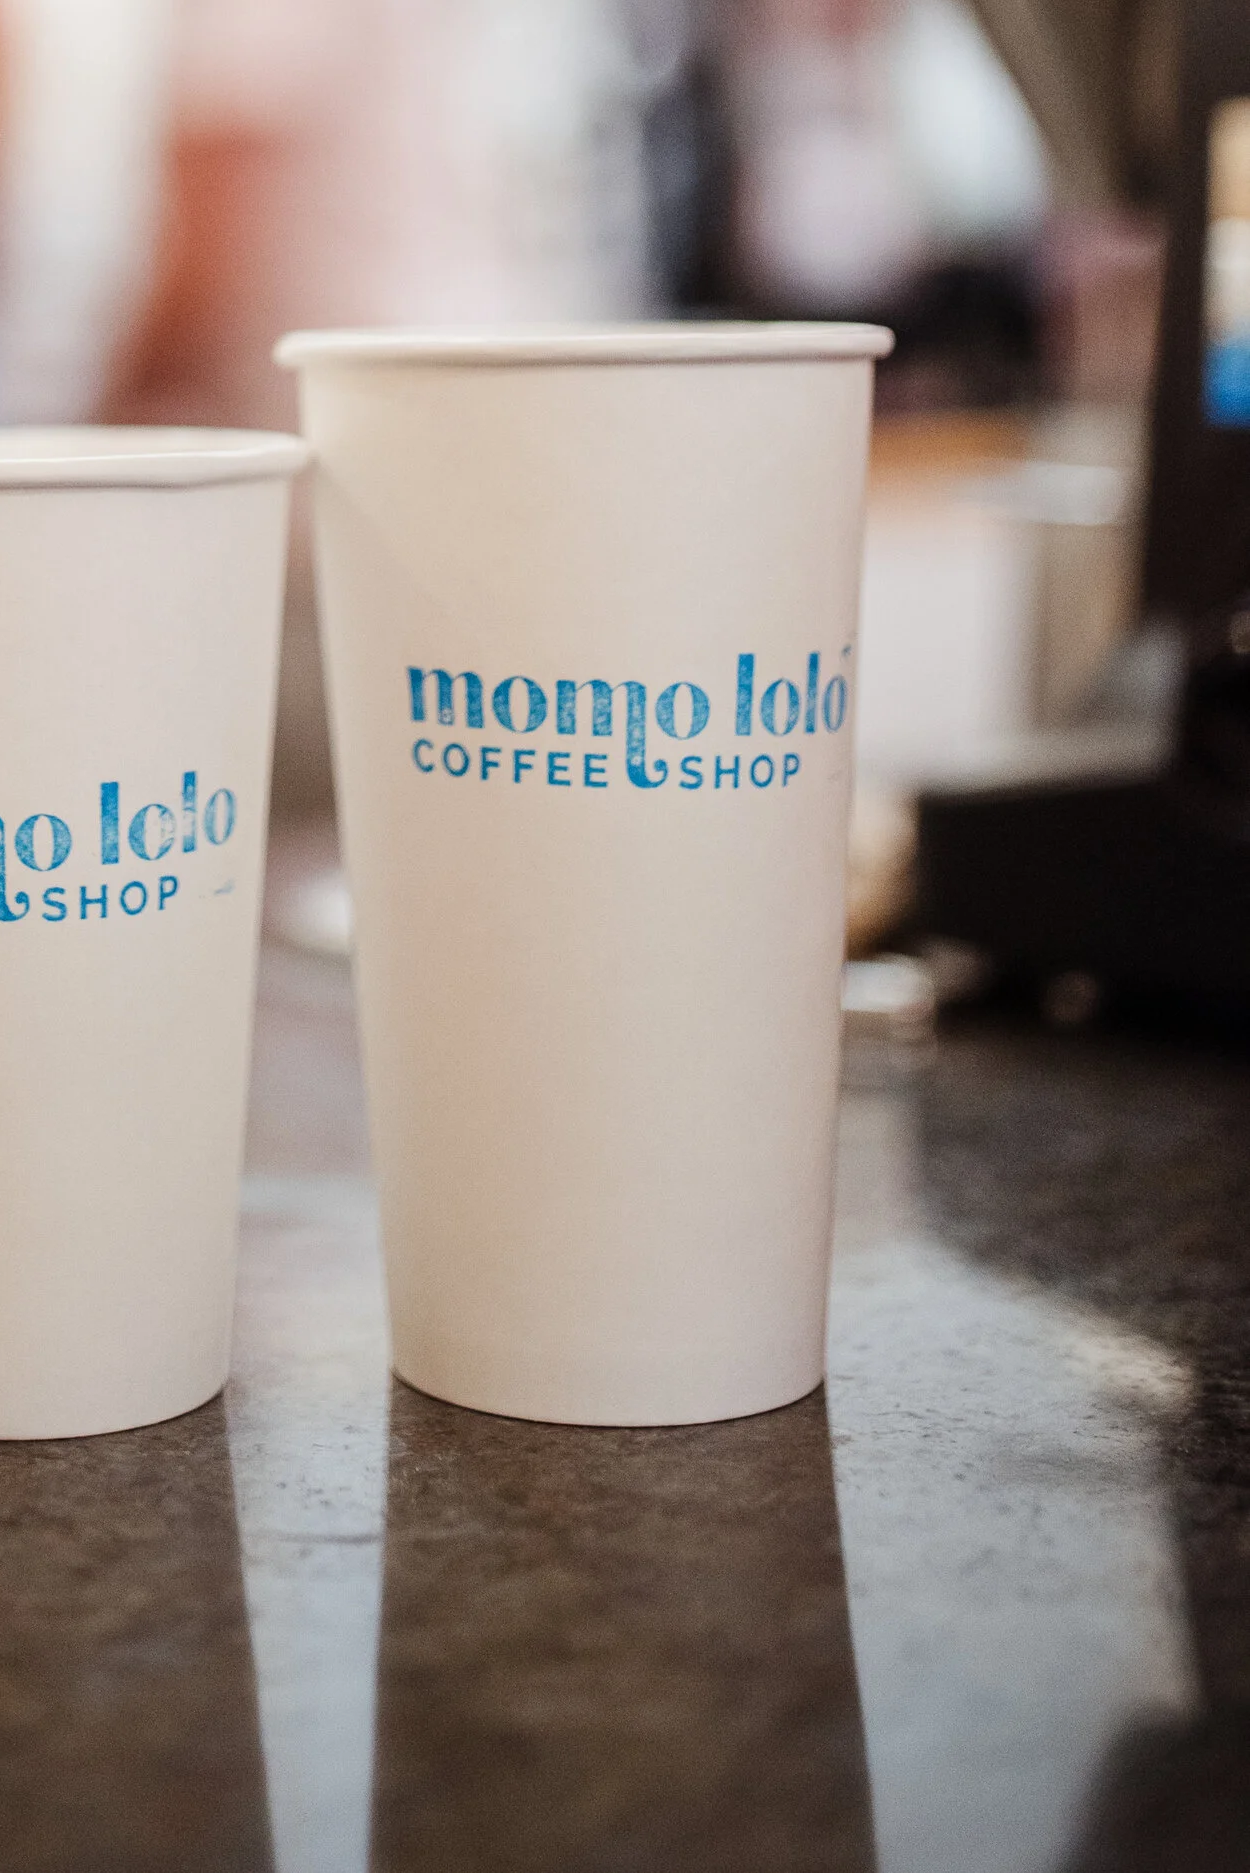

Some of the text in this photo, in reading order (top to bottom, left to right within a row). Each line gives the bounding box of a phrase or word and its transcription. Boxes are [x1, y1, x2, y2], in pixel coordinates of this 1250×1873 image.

[406, 666, 711, 790] momo
[412, 738, 802, 791] COFFEE SHOP
[41, 875, 180, 922] SHOP
